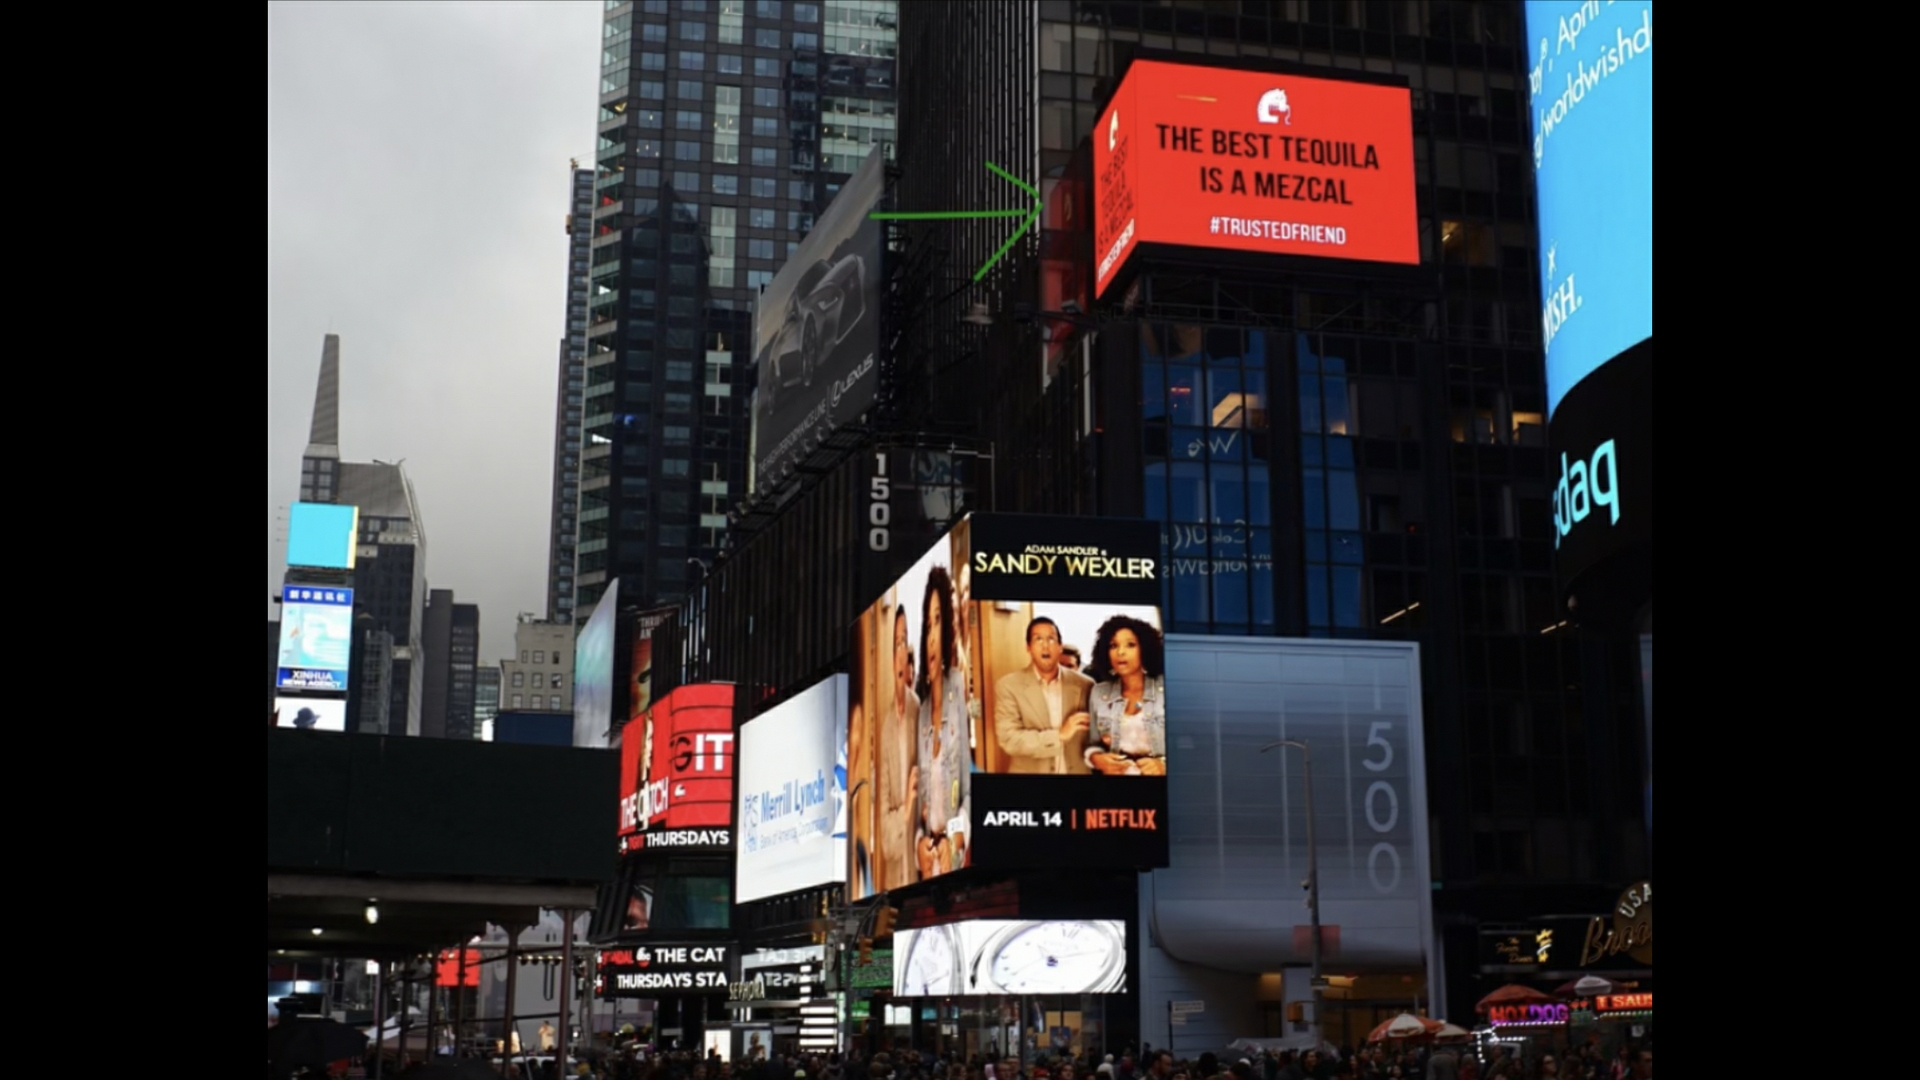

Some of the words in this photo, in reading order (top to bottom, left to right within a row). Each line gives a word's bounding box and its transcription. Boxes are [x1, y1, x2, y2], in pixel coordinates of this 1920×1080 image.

[1155, 123, 1204, 153] THE
[1212, 129, 1272, 159] BEST
[1280, 135, 1380, 170] TEQUILA
[1201, 166, 1223, 193] IS
[1231, 170, 1247, 196] A
[1255, 172, 1353, 206] MEZCAL
[1210, 216, 1347, 245] #TRUSTEDFRIEND
[841, 352, 874, 393] LEXUS
[869, 453, 890, 551] 1500
[1025, 544, 1056, 555] ADAM
[1057, 545, 1099, 556] SANDLER
[974, 551, 1058, 575] SANDY
[1065, 556, 1156, 580] WEXLER
[292, 670, 333, 681] XINHUA
[669, 733, 734, 772] GIT
[760, 783, 793, 824] Merrill
[795, 769, 825, 816] Lynch
[620, 793, 637, 830] THE
[983, 811, 1038, 826] APRIL
[1042, 811, 1062, 827] 14
[1085, 808, 1157, 830] NETFLIX
[647, 830, 730, 847] THURSDAYS
[655, 948, 687, 963] THE
[690, 947, 726, 963] CAT
[617, 972, 692, 989] THURSDAYS
[696, 971, 728, 987] STA
[729, 980, 765, 1000] SEPHORA
